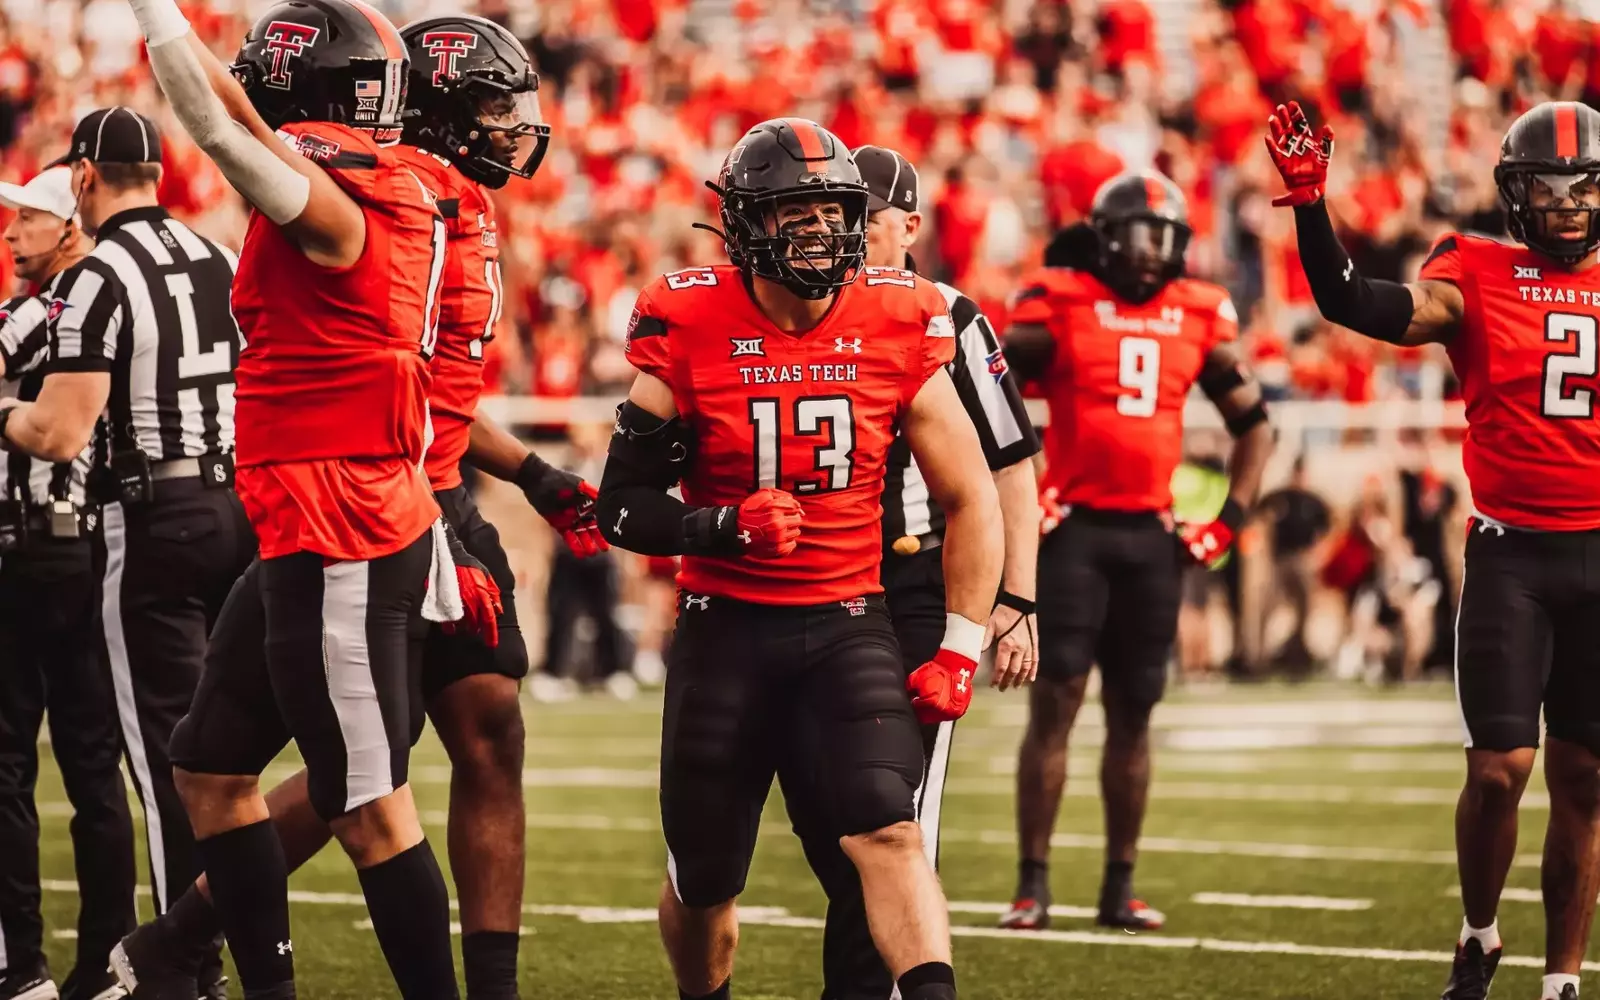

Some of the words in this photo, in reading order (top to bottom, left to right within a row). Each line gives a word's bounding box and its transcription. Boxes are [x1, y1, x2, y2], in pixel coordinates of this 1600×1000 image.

[354, 112, 376, 121] UNITY
[905, 190, 913, 203] S
[1518, 286, 1576, 303] TEXAS
[164, 272, 231, 379] L
[731, 338, 765, 357] XII
[739, 365, 803, 384] TEXAS
[809, 364, 857, 381] TECH
[1116, 336, 1160, 418] 9
[748, 394, 857, 495] 13
[213, 463, 227, 483] S
